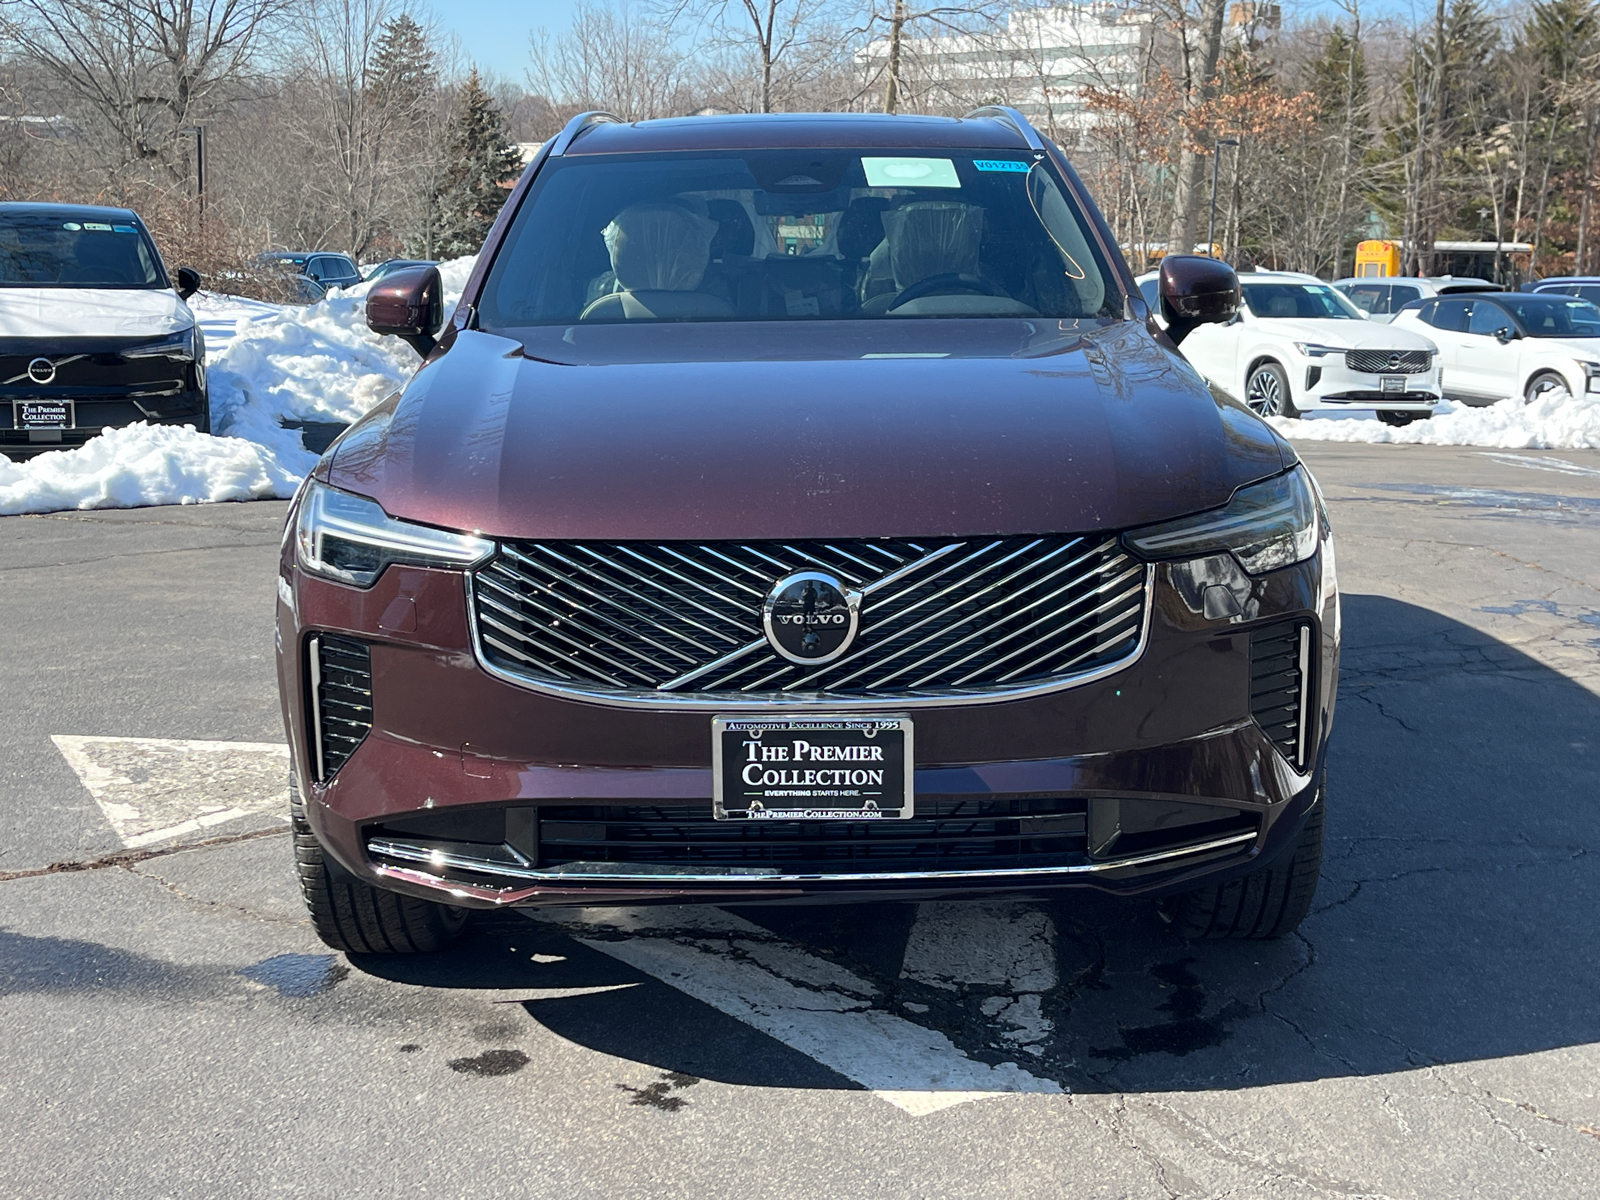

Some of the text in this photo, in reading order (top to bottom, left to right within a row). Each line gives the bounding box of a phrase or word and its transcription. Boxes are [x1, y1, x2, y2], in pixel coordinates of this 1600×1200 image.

[37, 405, 66, 413] PREMIER
[776, 614, 845, 625] VOLVO
[728, 721, 899, 730] AUTOMOTIVE EXCELLENCE SINCE 1995
[742, 740, 884, 762] THE PREMIER
[741, 763, 884, 786] COLLECTION
